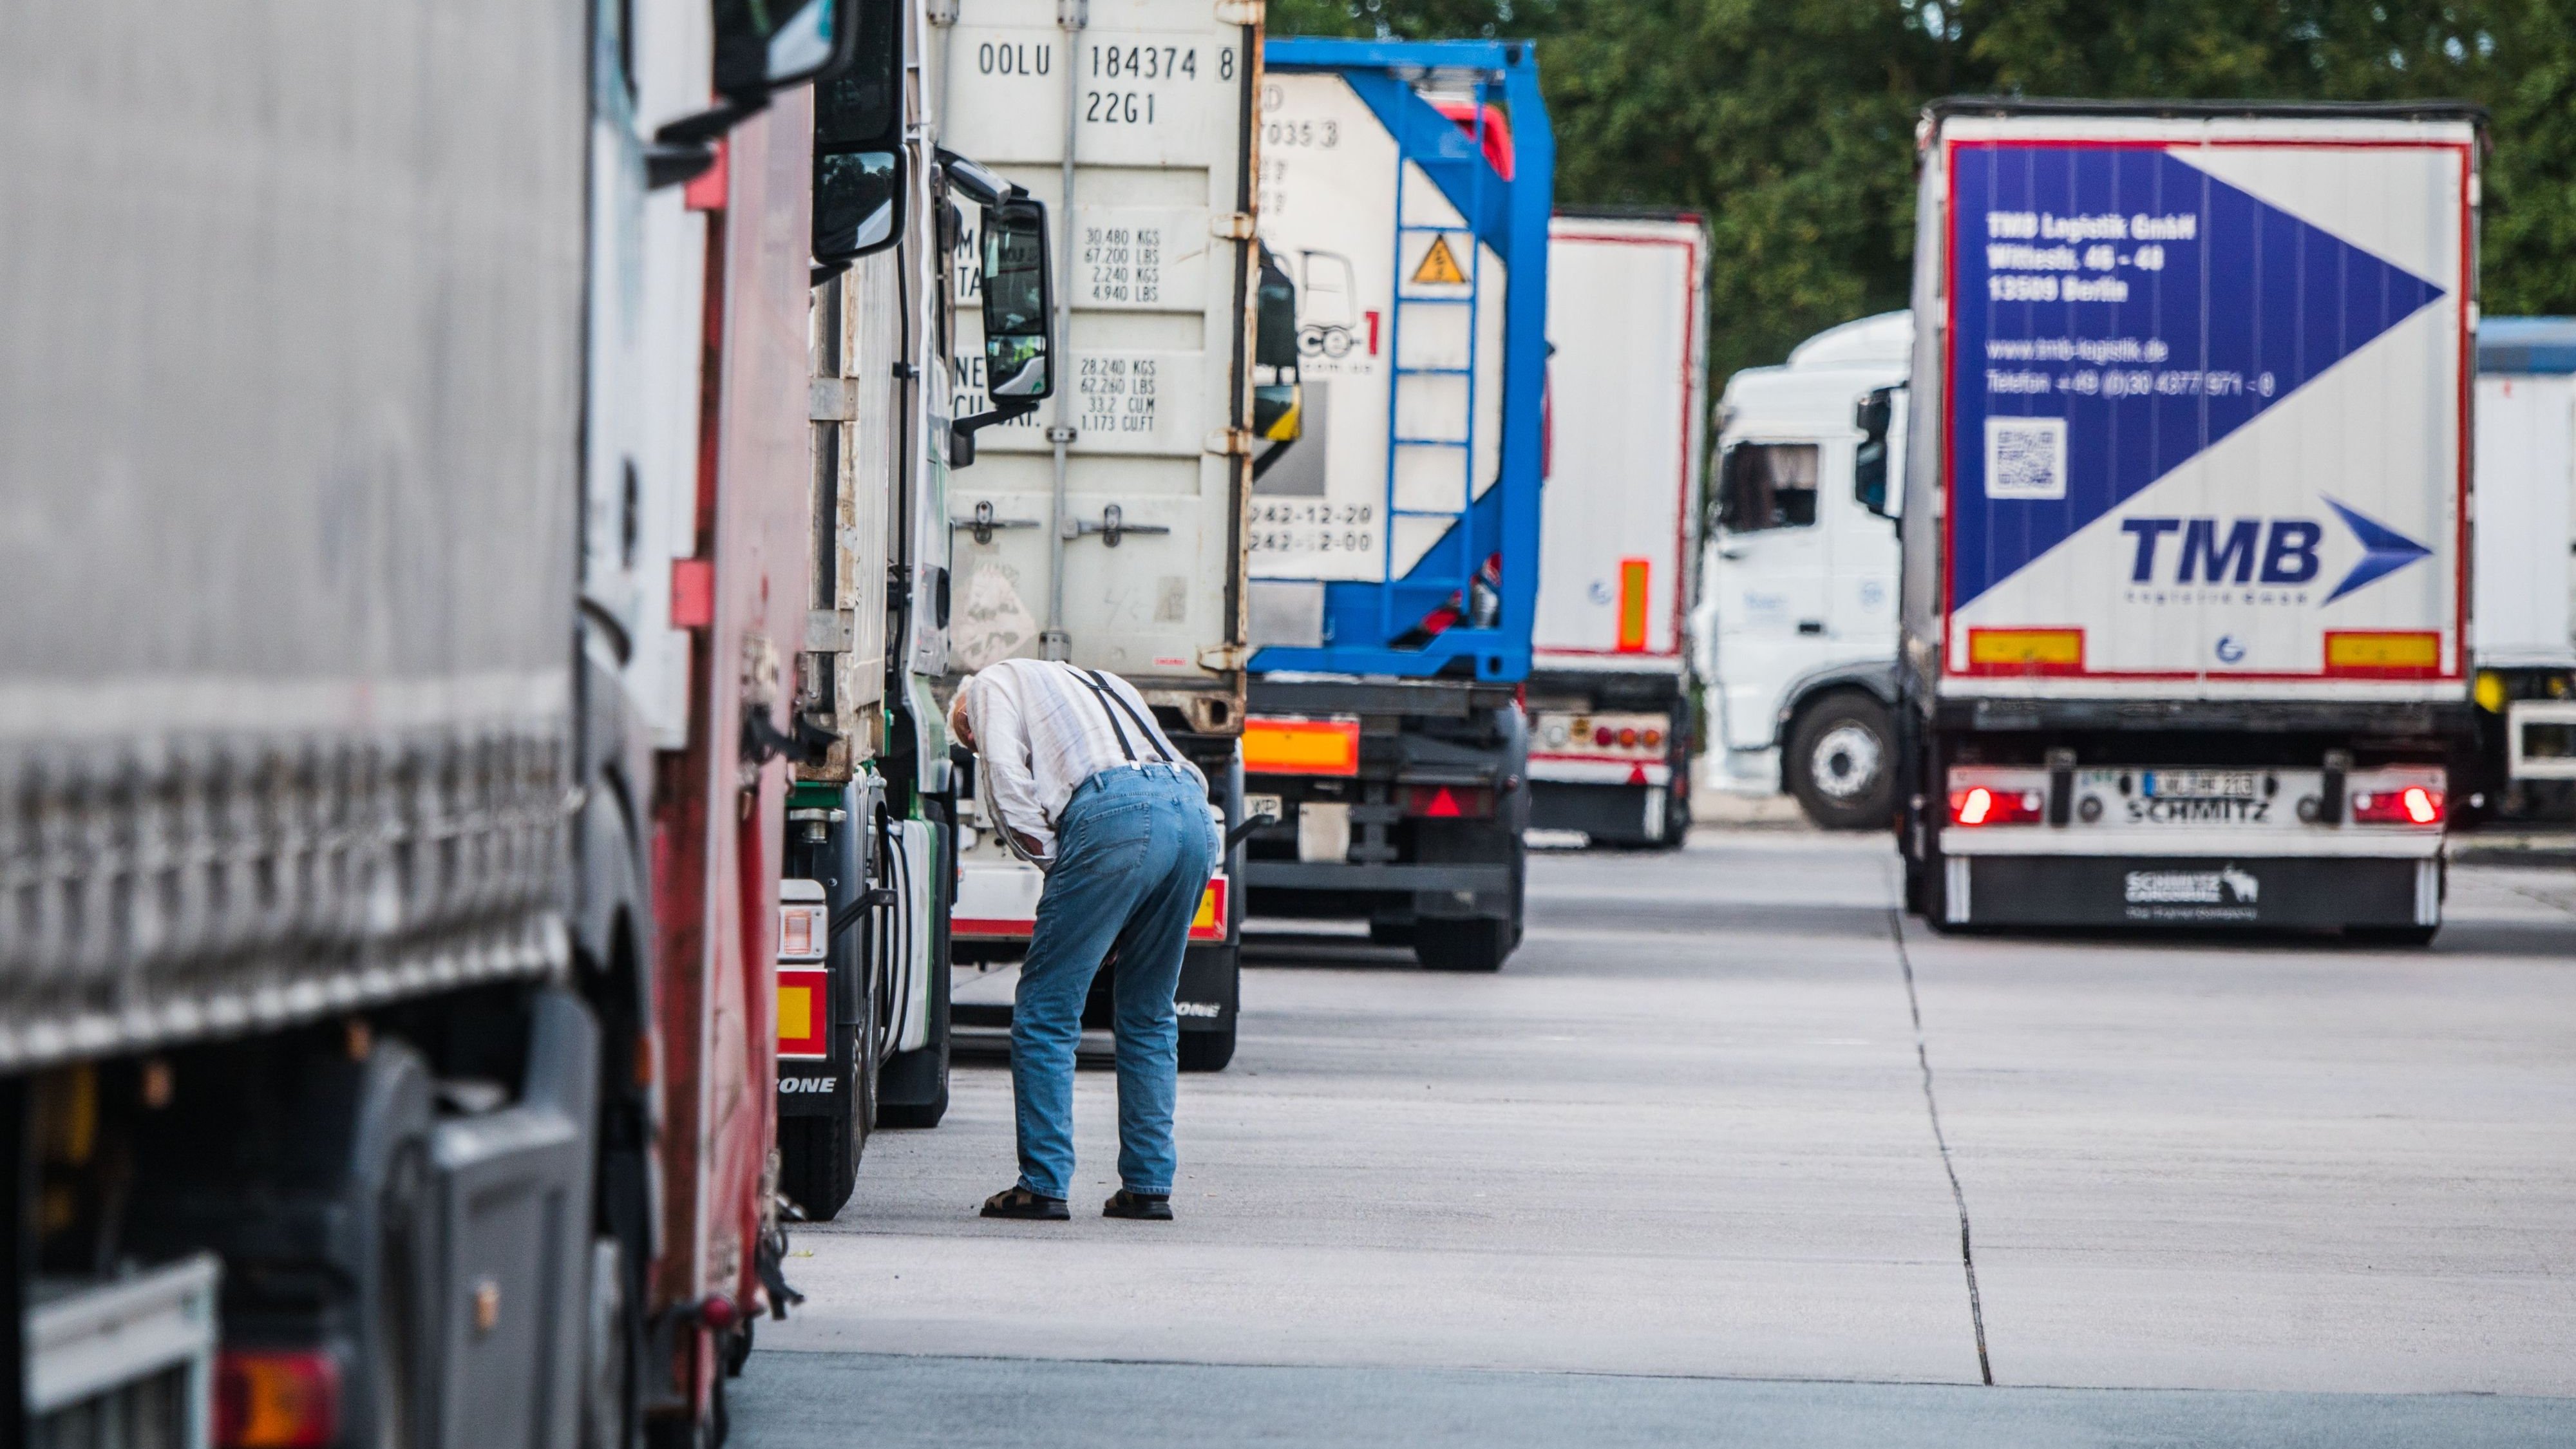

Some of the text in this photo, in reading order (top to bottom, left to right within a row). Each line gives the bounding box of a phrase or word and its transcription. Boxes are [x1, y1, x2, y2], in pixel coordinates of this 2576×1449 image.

[1093, 46, 1196, 80] 184374
[1220, 48, 1233, 80] 8
[1086, 91, 1154, 124] 22G1
[1137, 229, 1159, 246] KGS
[1137, 249, 1159, 265] LBS
[958, 267, 981, 296] TA
[1136, 267, 1159, 283] KGS
[1136, 286, 1158, 302] LBS
[955, 356, 984, 388] NE
[1133, 360, 1156, 376] KGS
[1133, 379, 1156, 395] LBS
[1081, 415, 1115, 431] 1.173
[1248, 531, 1372, 552] 242-2-00
[2123, 518, 2321, 584] TMB
[2126, 799, 2272, 824] SCHMITZ
[1176, 1002, 1221, 1018] ONE
[776, 1077, 837, 1094] ONE
